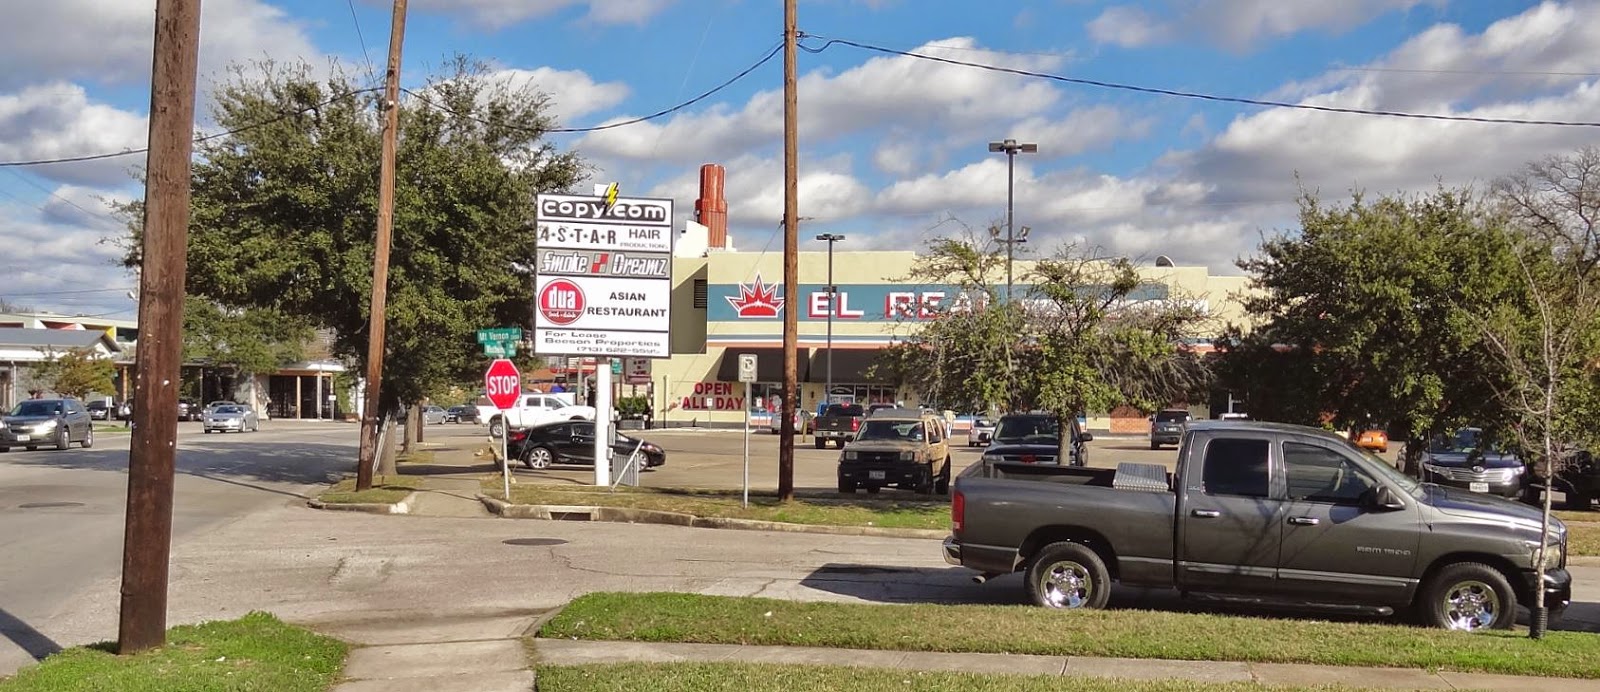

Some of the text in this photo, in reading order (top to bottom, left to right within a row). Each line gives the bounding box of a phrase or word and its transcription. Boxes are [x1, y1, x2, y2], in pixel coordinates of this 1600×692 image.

[629, 229, 660, 239] HAIR
[540, 251, 668, 276] Smoke Dreamz
[549, 286, 576, 309] dua
[609, 292, 646, 301] ASIAN
[587, 306, 667, 317] RESTAURANT
[808, 292, 864, 319] EL
[595, 339, 661, 347] Properties
[488, 376, 517, 395] STOP
[694, 382, 732, 395] OPEN
[682, 397, 743, 410] ALL DAY
